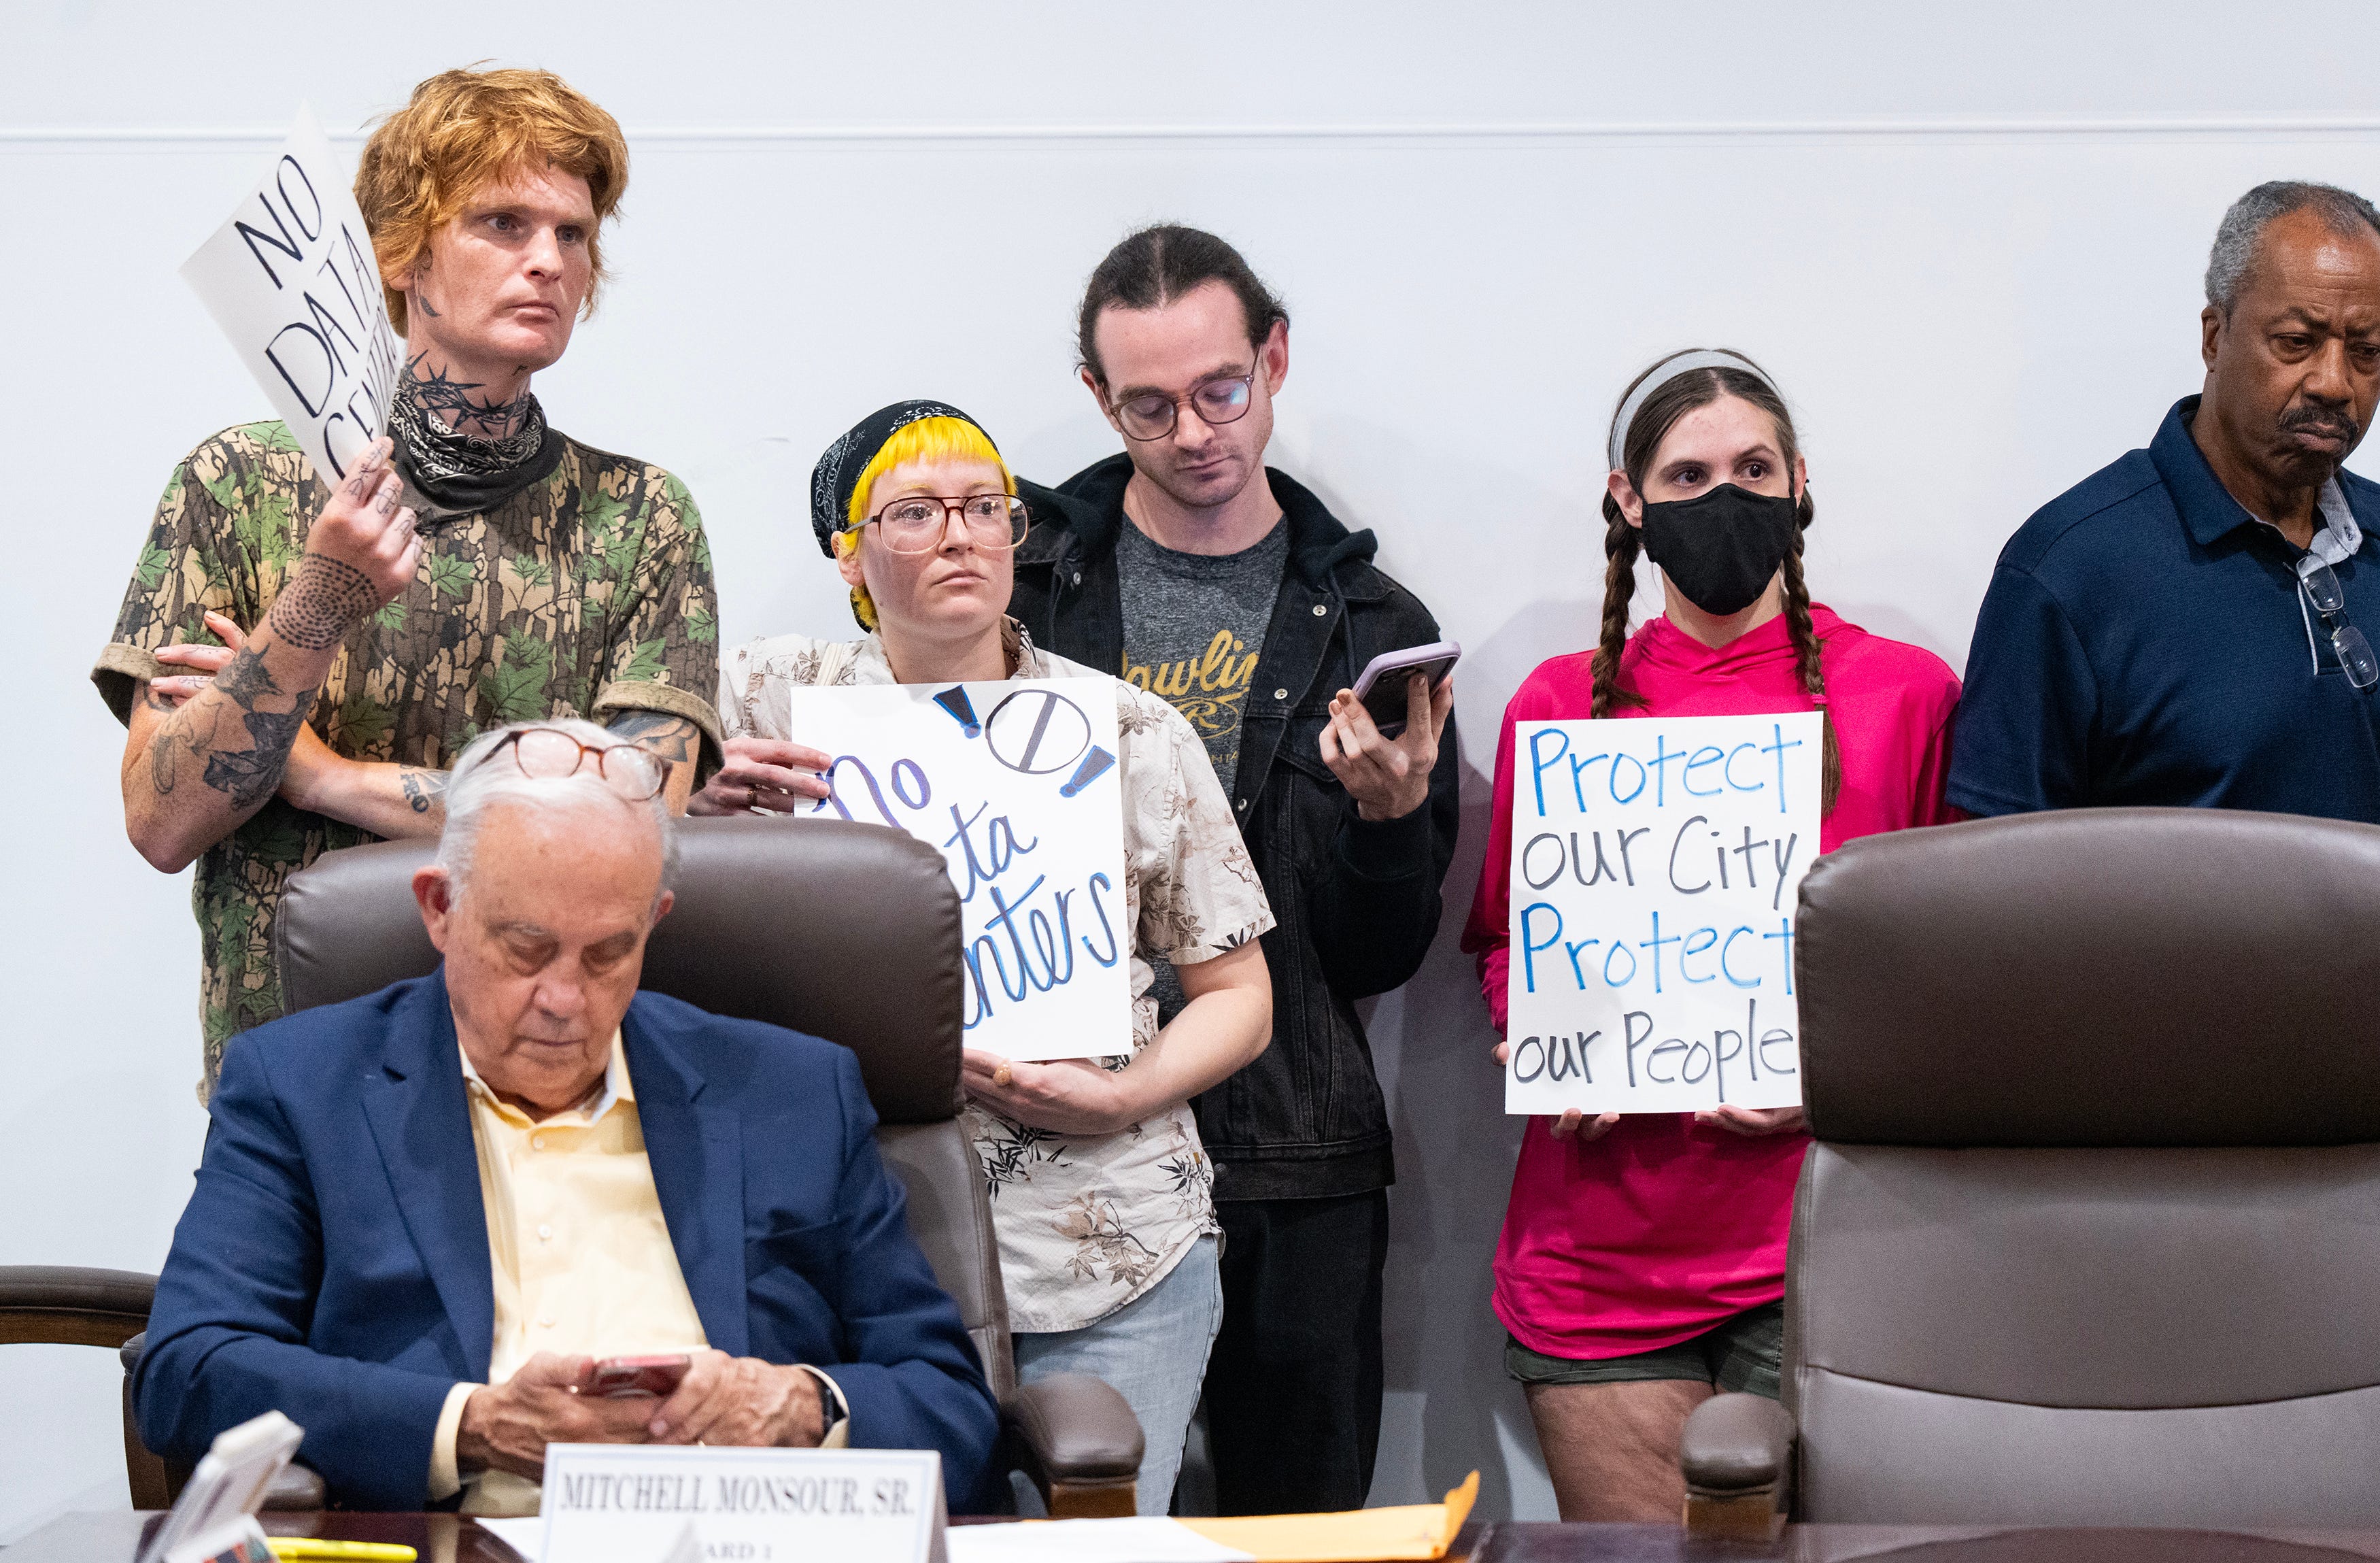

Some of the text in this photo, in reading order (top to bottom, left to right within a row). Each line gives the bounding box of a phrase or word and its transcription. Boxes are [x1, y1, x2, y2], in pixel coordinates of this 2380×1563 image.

[235, 154, 321, 290] NO
[265, 221, 376, 418] DATA
[1529, 723, 1803, 817] Protect
[942, 800, 1040, 903] ta
[1522, 815, 1799, 911] our City
[962, 871, 1119, 1030] nters
[1520, 901, 1796, 995] Protect
[1514, 998, 1796, 1104] our People
[561, 1472, 916, 1519] MITCHELL MONSOUR, SR.
[707, 1541, 757, 1560] ARD
